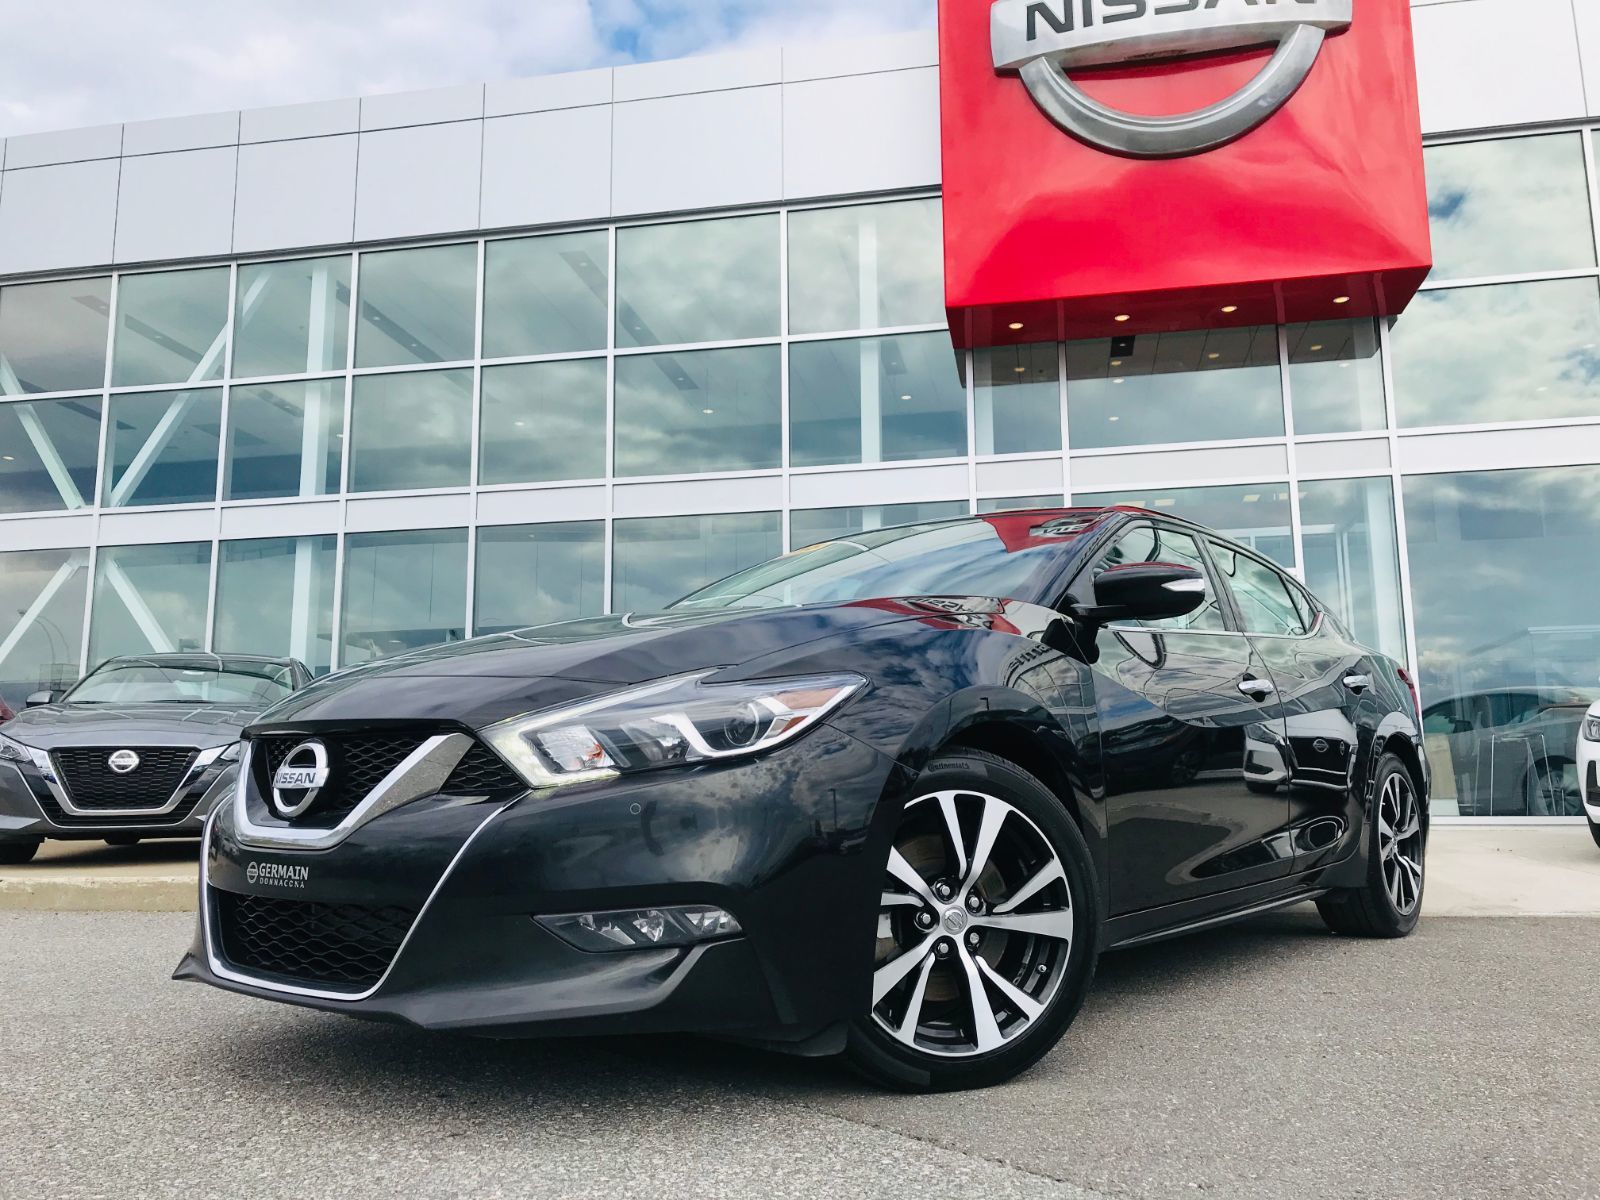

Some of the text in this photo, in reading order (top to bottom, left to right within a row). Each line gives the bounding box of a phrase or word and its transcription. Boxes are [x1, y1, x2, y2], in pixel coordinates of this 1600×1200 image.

[1026, 0, 1315, 41] NIS
[275, 772, 316, 784] NISSAN
[259, 863, 309, 881] GERMAIN
